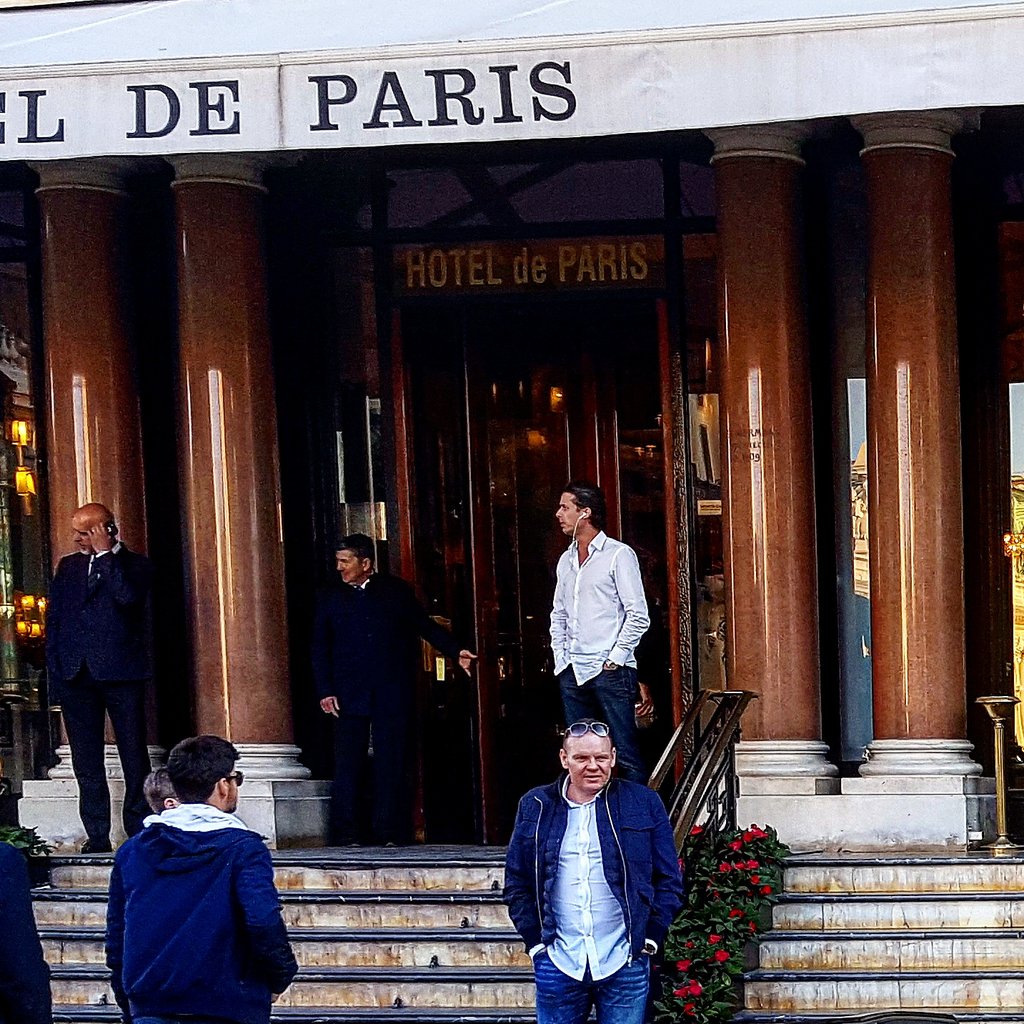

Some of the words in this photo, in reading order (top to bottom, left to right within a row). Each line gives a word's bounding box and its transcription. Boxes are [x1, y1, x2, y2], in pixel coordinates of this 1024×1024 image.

[0, 90, 65, 144] L
[126, 80, 241, 139] DE
[308, 61, 578, 132] PARIS
[407, 248, 503, 288] HOTEL
[513, 246, 548, 284] de
[558, 241, 649, 282] PARIS
